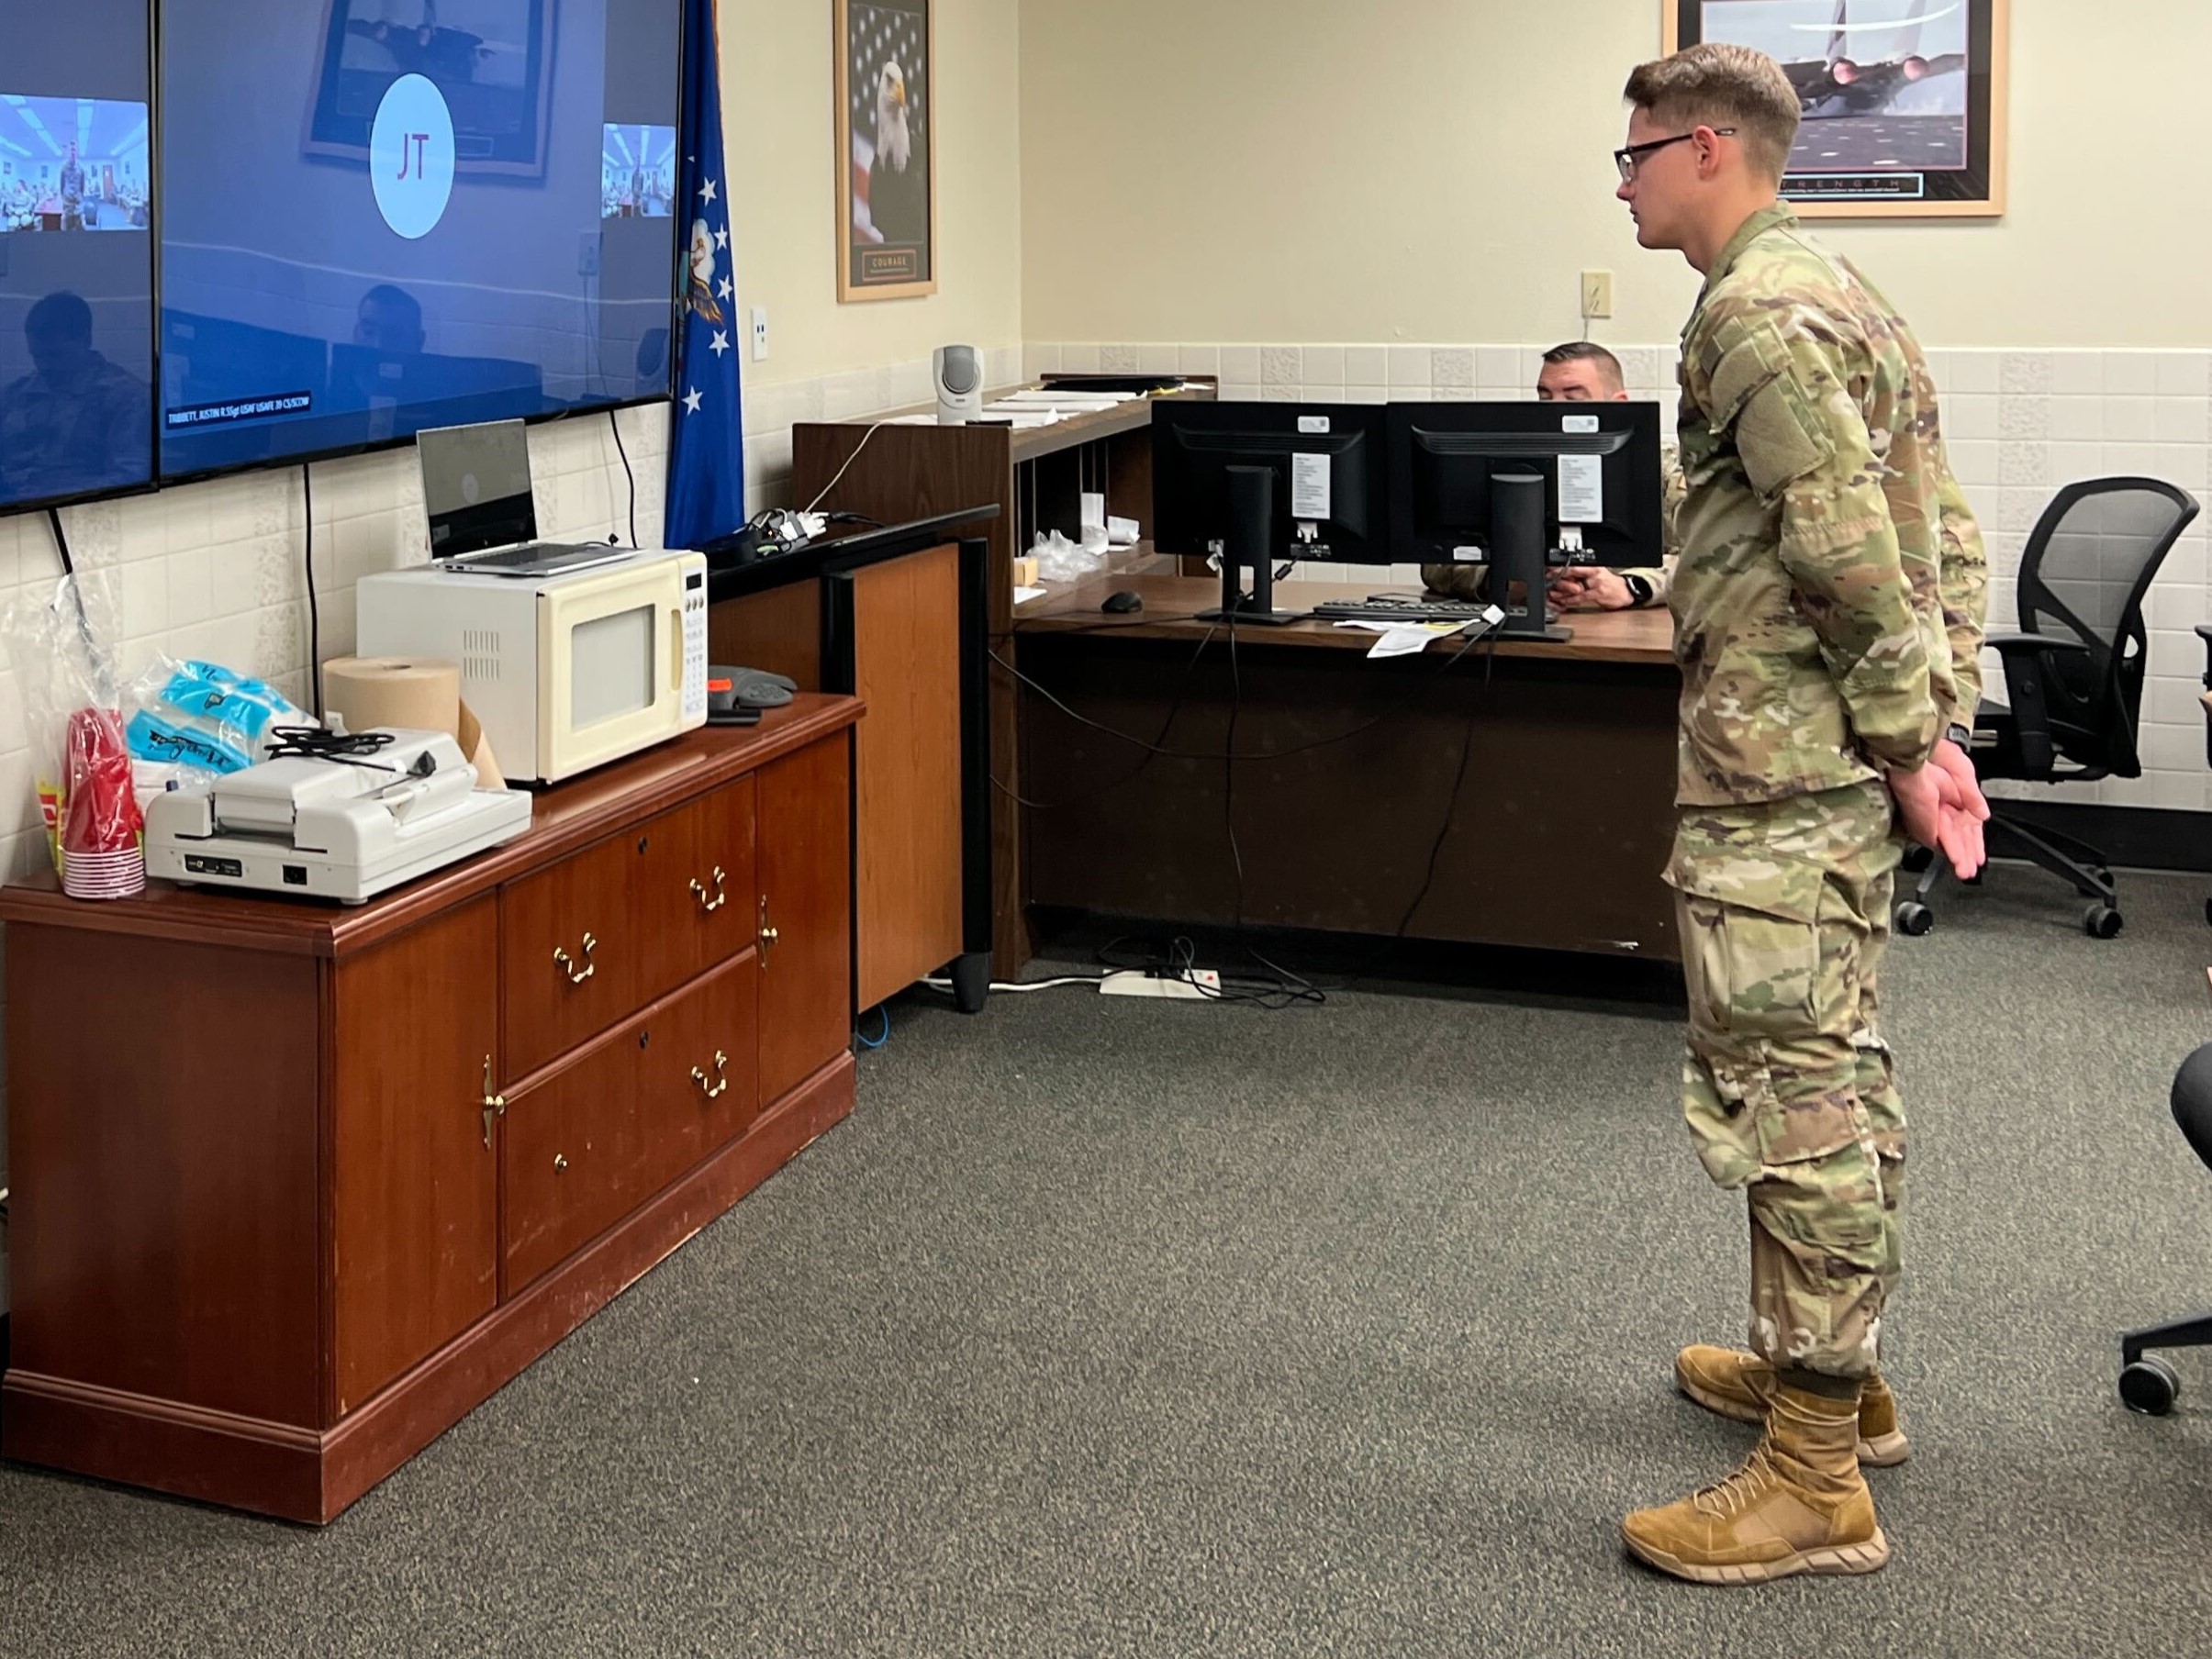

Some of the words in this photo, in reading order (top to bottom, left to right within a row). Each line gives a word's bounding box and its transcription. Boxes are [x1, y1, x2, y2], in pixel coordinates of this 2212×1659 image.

[397, 133, 430, 180] JT
[1781, 179, 1899, 188] TRENGTH
[872, 256, 907, 268] COURAGE
